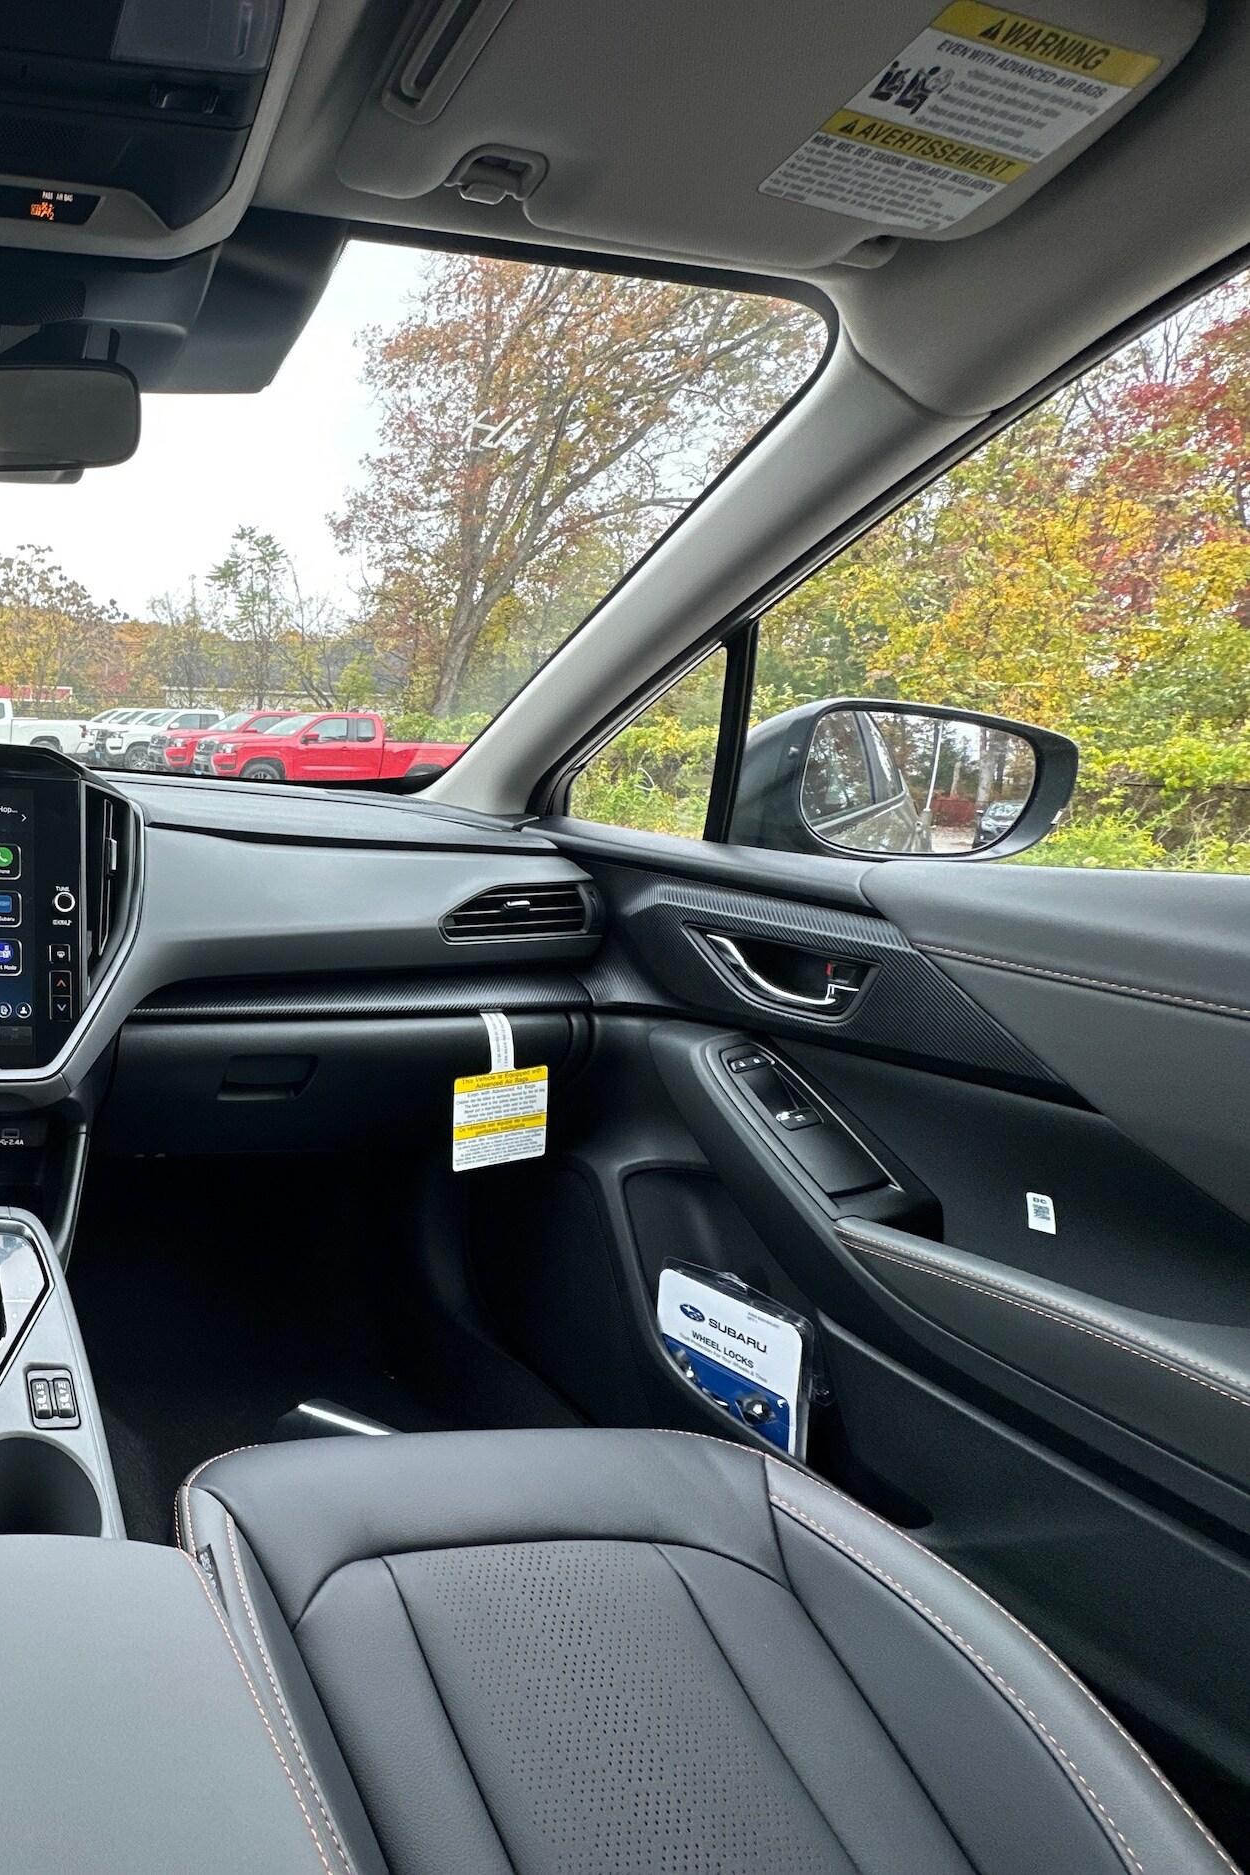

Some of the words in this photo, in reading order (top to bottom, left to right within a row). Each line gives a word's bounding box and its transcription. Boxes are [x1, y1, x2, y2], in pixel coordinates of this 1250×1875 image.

[937, 39, 969, 57] EVEN
[968, 49, 1000, 65] WITH
[996, 58, 1058, 83] ADVANCED
[1053, 76, 1078, 89] AIR
[1072, 82, 1108, 99] BAGS
[1001, 21, 1110, 71] WARNING
[855, 122, 1016, 177] AVERTISSEMENT
[691, 1329, 721, 1352] WHEEL
[723, 1347, 754, 1369] LOCKS
[708, 1317, 768, 1353] SUBARU
